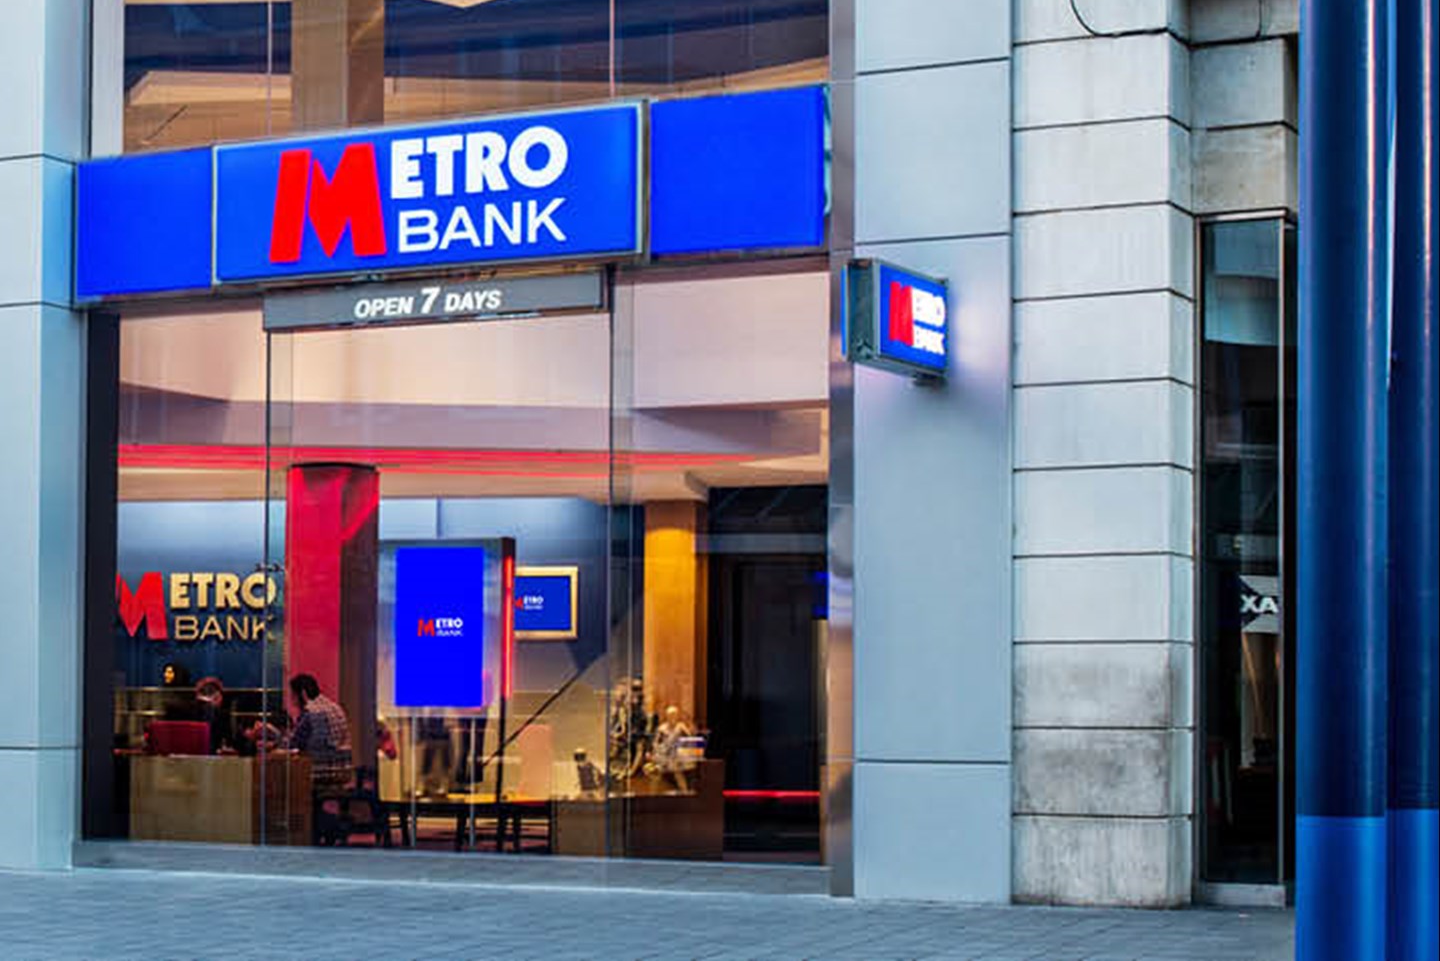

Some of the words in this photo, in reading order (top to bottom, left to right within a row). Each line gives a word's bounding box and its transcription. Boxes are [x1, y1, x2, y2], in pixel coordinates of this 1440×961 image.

[269, 126, 568, 262] METRO
[398, 198, 567, 253] BANK
[354, 296, 413, 318] OPEN
[420, 287, 440, 314] 7
[444, 290, 501, 311] DAYS
[115, 571, 277, 640] METRO
[417, 617, 463, 637] METRO
[174, 615, 275, 640] BANK
